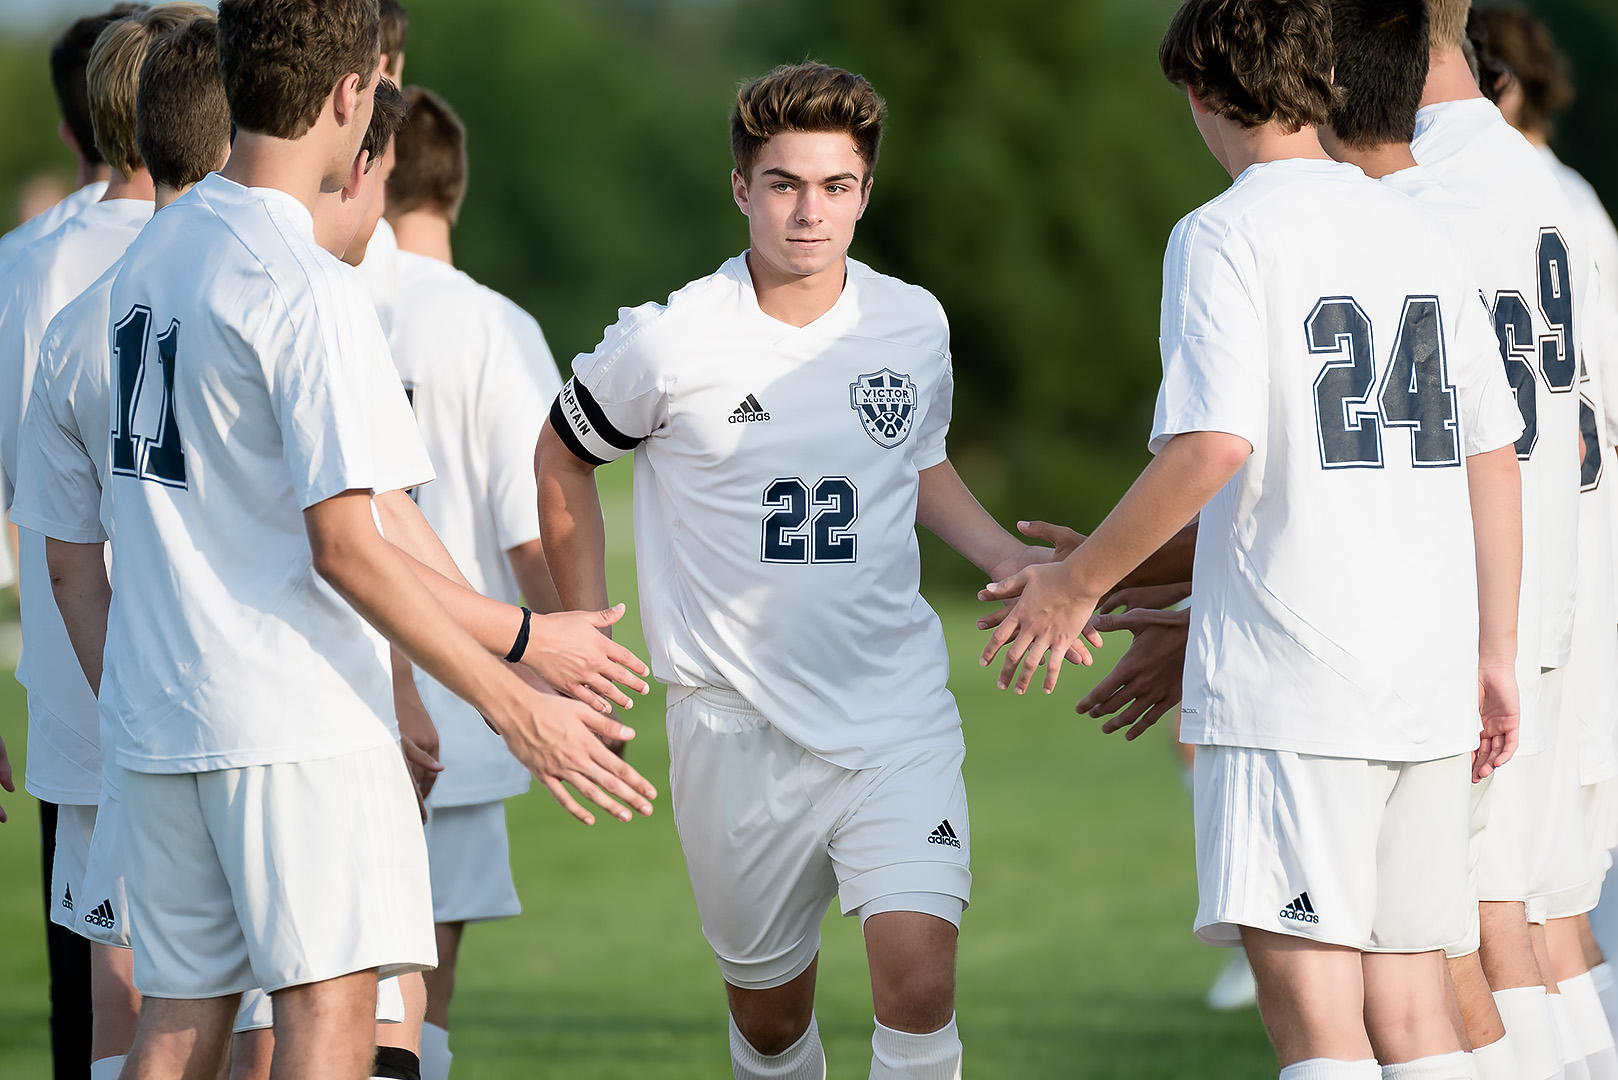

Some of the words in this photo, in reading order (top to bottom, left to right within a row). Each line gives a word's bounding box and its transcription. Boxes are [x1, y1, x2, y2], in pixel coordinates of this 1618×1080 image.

[1536, 226, 1577, 394] 9
[111, 303, 188, 491] 11
[862, 389, 909, 399] VICTOR
[1303, 294, 1461, 470] 24
[728, 411, 771, 424] adidas
[760, 475, 859, 565] 22
[927, 834, 961, 849] adidas
[1279, 909, 1319, 924] adidas
